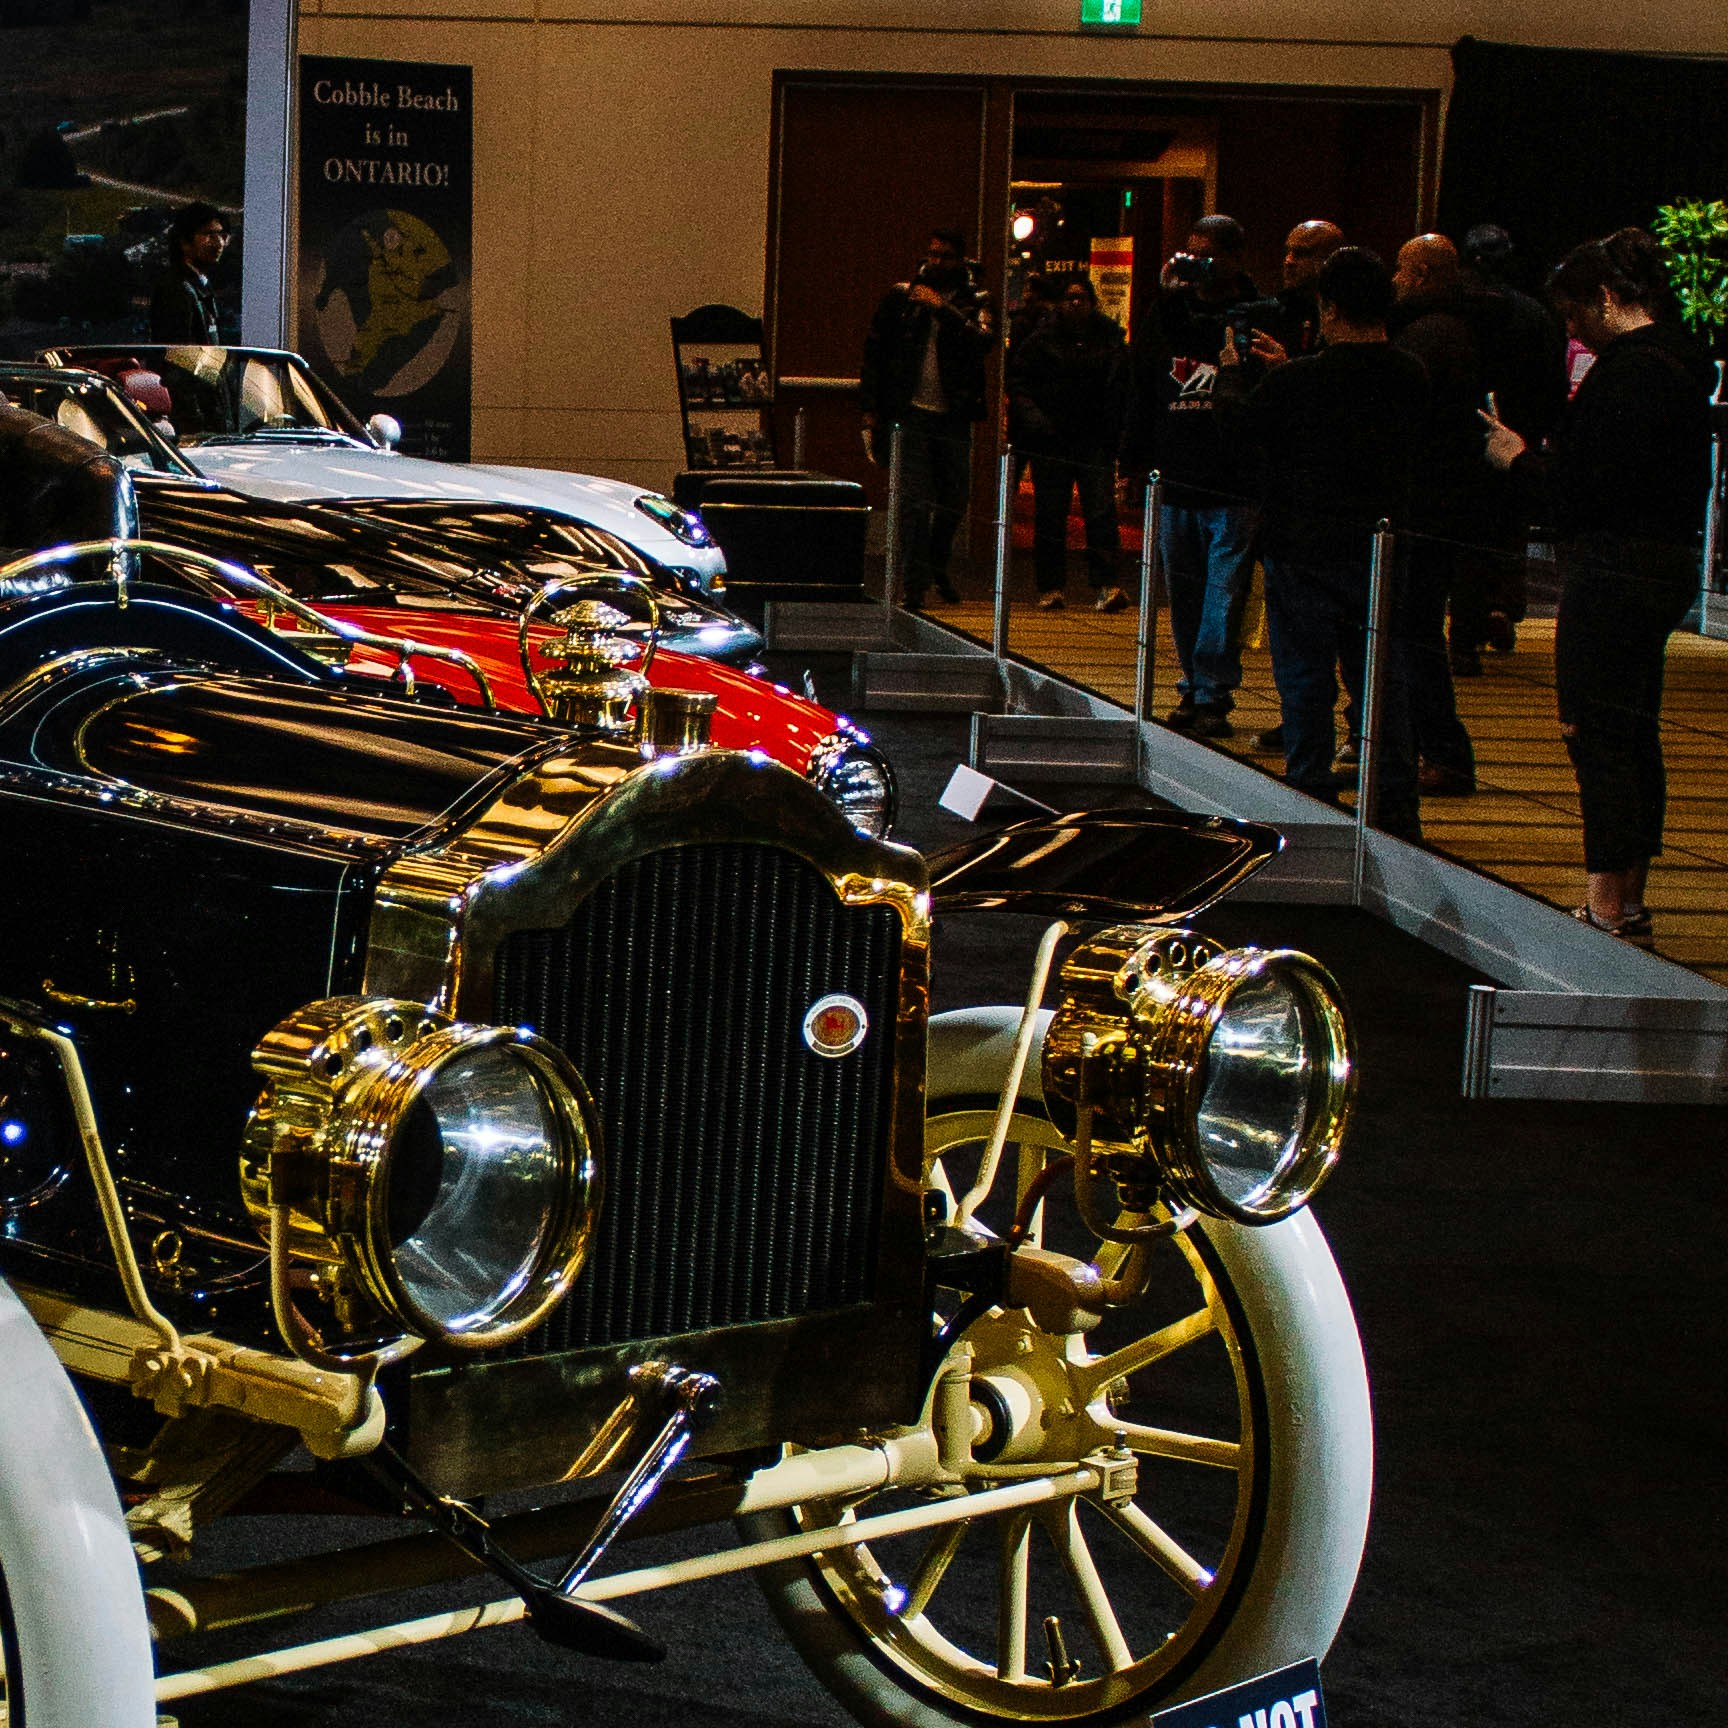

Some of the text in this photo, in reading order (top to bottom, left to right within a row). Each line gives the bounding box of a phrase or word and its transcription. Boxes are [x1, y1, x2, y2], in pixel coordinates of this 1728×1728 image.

[313, 80, 459, 112] Cobble Beach
[364, 123, 409, 148] is in
[323, 158, 450, 187] ONTARIO!
[1044, 259, 1075, 273] EXIT
